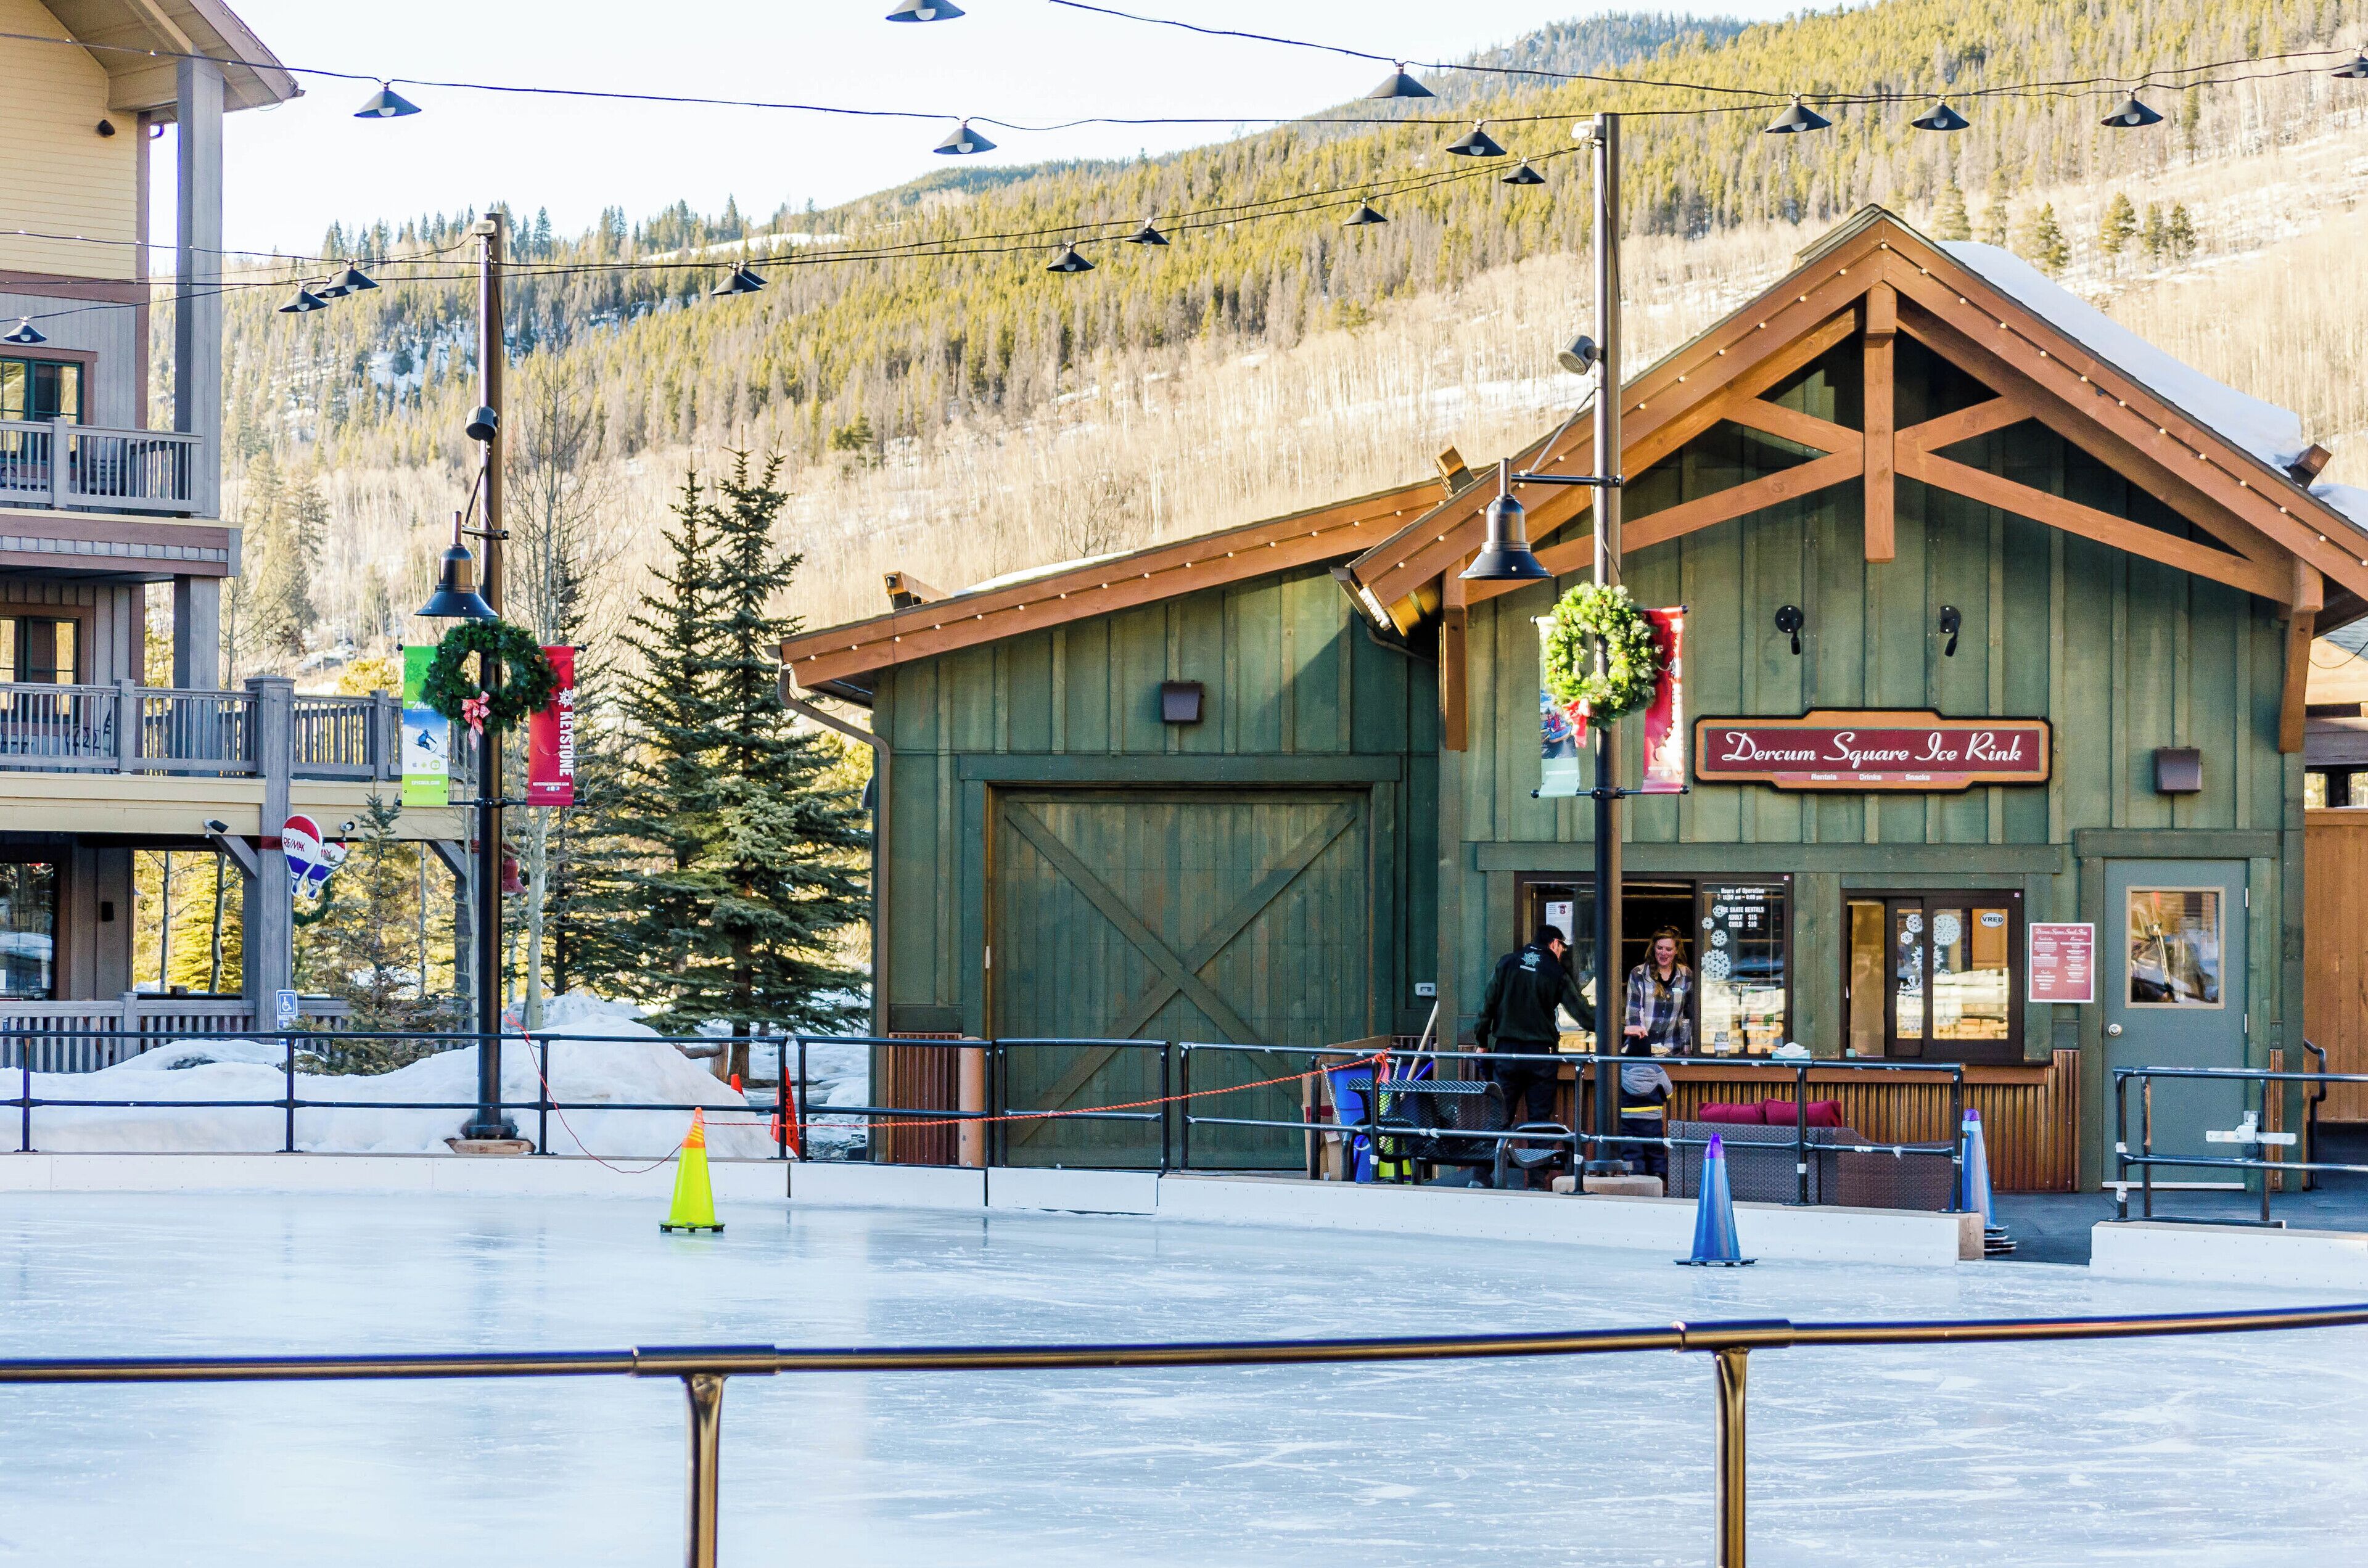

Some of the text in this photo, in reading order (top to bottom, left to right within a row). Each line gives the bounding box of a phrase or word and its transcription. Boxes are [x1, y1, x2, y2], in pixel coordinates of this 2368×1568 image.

[559, 712, 574, 778] KEYSTONE
[1721, 731, 2023, 770] Dercum Square Ice Rink
[1811, 773, 1931, 781] Rentals Drinks Snacks
[284, 836, 306, 853] RE/MAX
